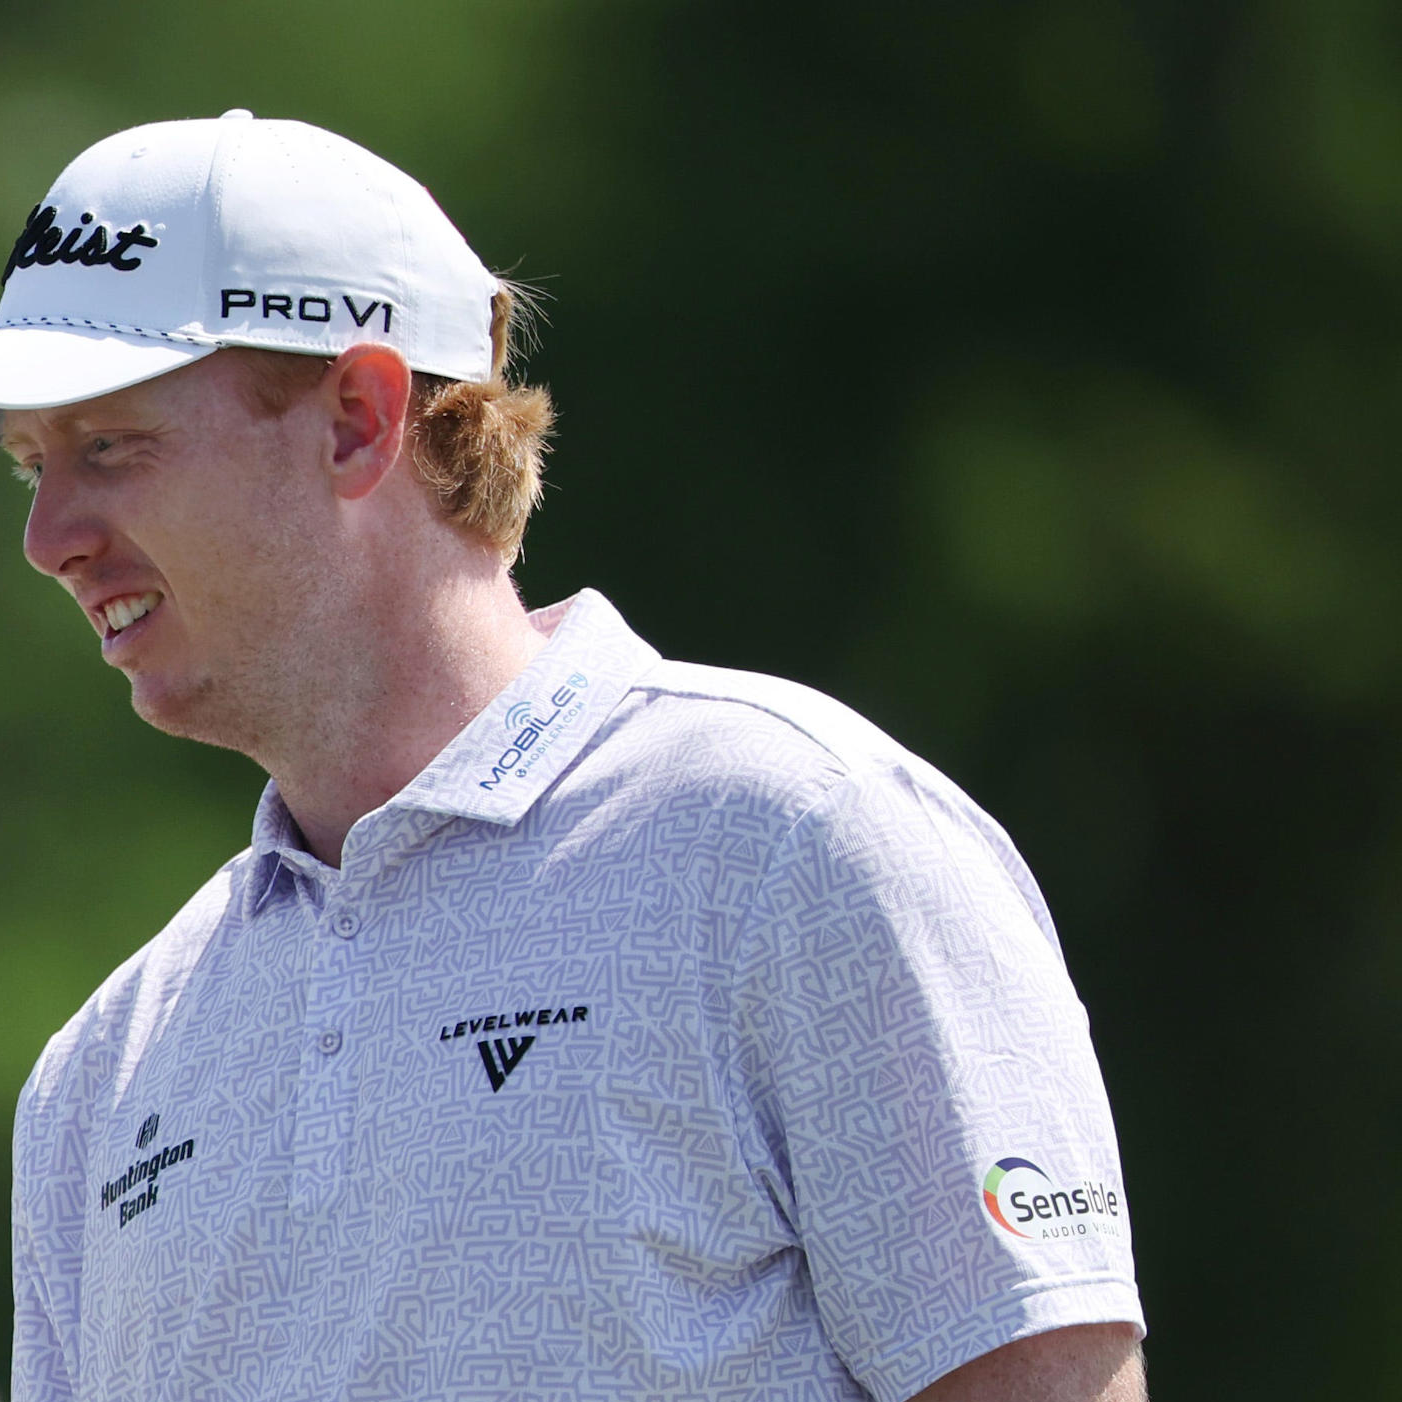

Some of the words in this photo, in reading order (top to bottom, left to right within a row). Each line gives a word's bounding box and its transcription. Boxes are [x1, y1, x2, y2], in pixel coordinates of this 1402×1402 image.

[220, 288, 331, 323] PRO
[342, 295, 394, 334] V1
[440, 1006, 588, 1041] LEVELWEAR
[101, 1139, 194, 1212] Huntington
[120, 1183, 159, 1229] Bank
[1010, 1181, 1119, 1222] Sensible
[1042, 1223, 1087, 1240] AUDIO
